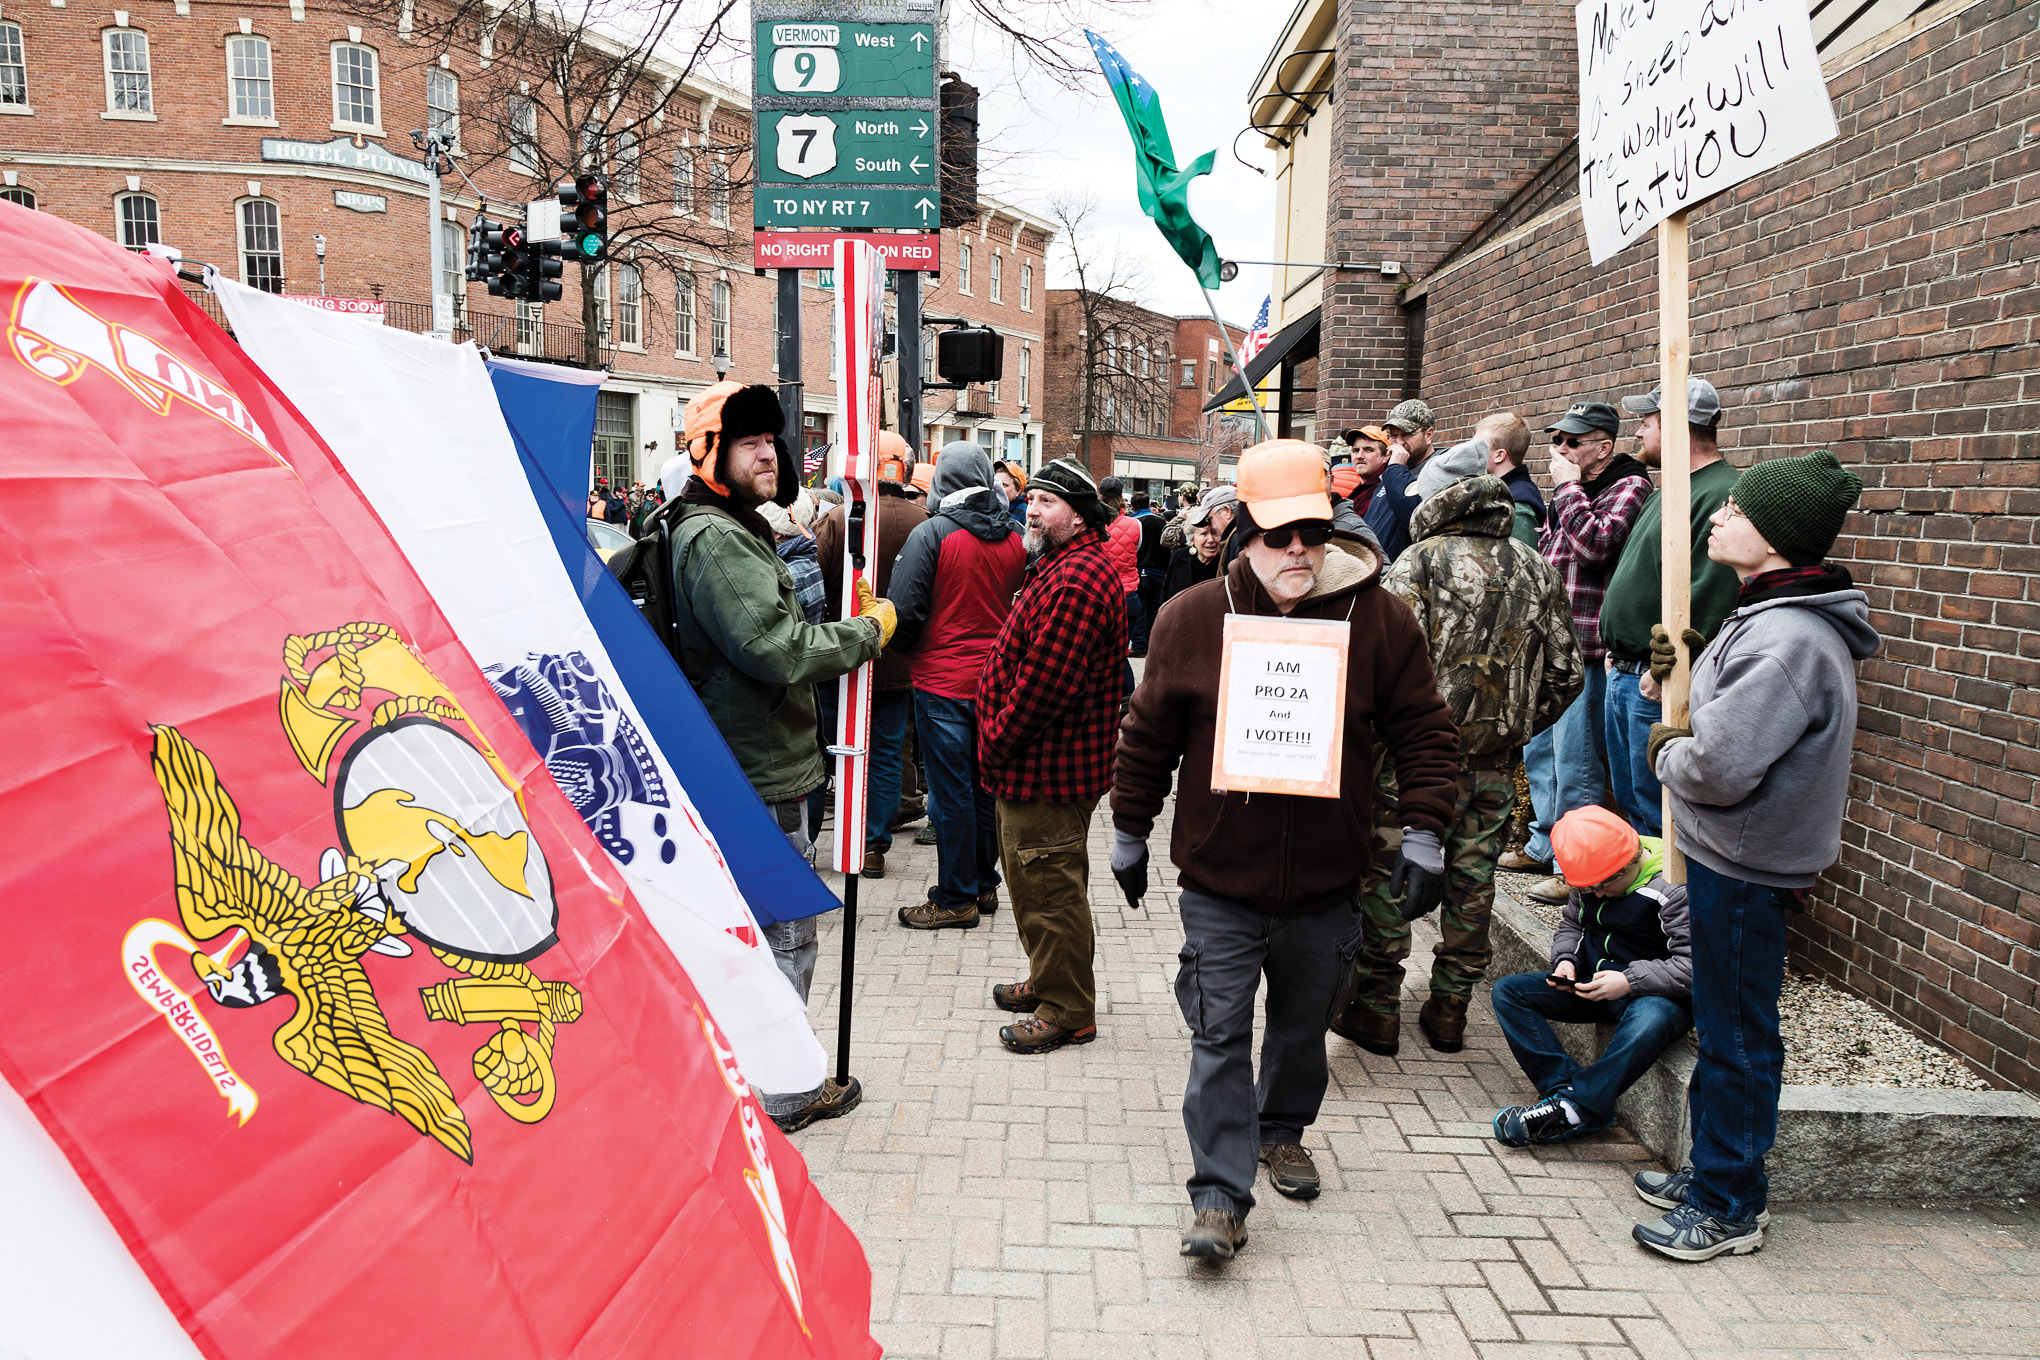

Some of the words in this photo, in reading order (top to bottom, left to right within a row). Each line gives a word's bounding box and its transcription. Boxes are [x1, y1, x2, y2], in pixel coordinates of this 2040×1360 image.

[776, 28, 836, 43] VERMONT
[855, 32, 895, 48] West
[794, 52, 816, 88] 9
[855, 120, 899, 135] North
[275, 143, 346, 163] HOTEL
[792, 129, 817, 164] 7
[855, 157, 901, 172] South
[337, 192, 385, 210] SHOPS
[773, 199, 798, 215] TO
[803, 200, 827, 215] NY
[832, 200, 855, 215] RT
[860, 201, 870, 216] 7
[761, 243, 782, 257] NO
[786, 244, 830, 257] RIGHT
[877, 245, 898, 258] ON
[902, 246, 932, 259] RED
[339, 300, 384, 313] SOON!
[1275, 661, 1300, 674] AM
[1255, 685, 1285, 698] PRO
[1290, 687, 1309, 700] 2A
[1269, 710, 1291, 719] And
[1255, 729, 1311, 744] VOTE!!!
